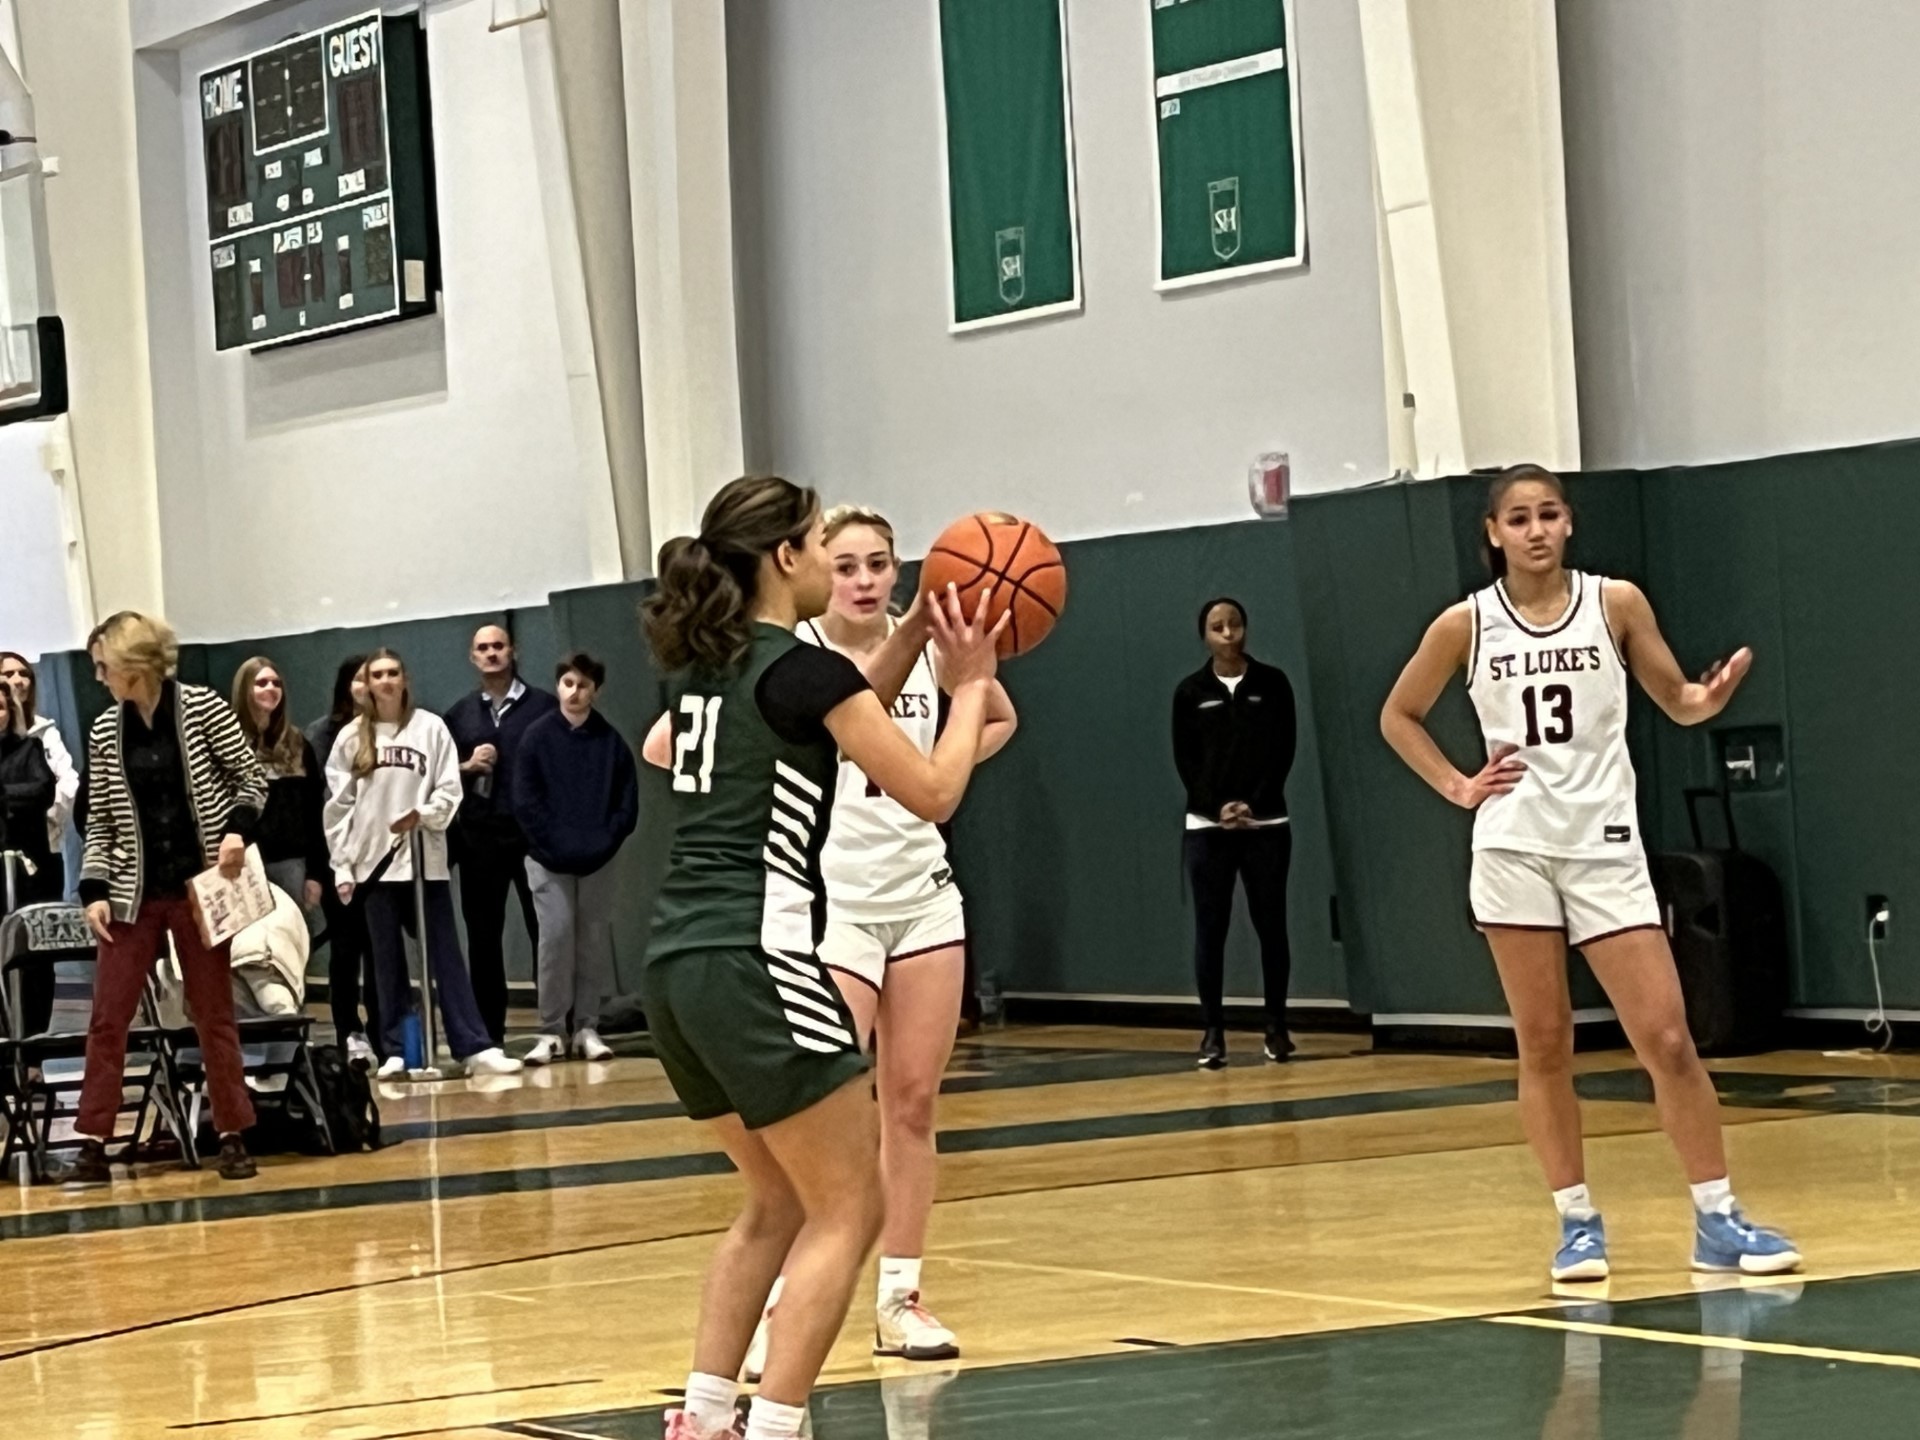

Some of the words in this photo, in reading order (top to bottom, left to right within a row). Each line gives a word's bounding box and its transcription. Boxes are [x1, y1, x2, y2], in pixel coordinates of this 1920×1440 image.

[329, 23, 379, 77] GUEST
[1523, 645, 1601, 677] LUKE'S
[672, 694, 723, 793] 21
[1521, 683, 1574, 748] 13
